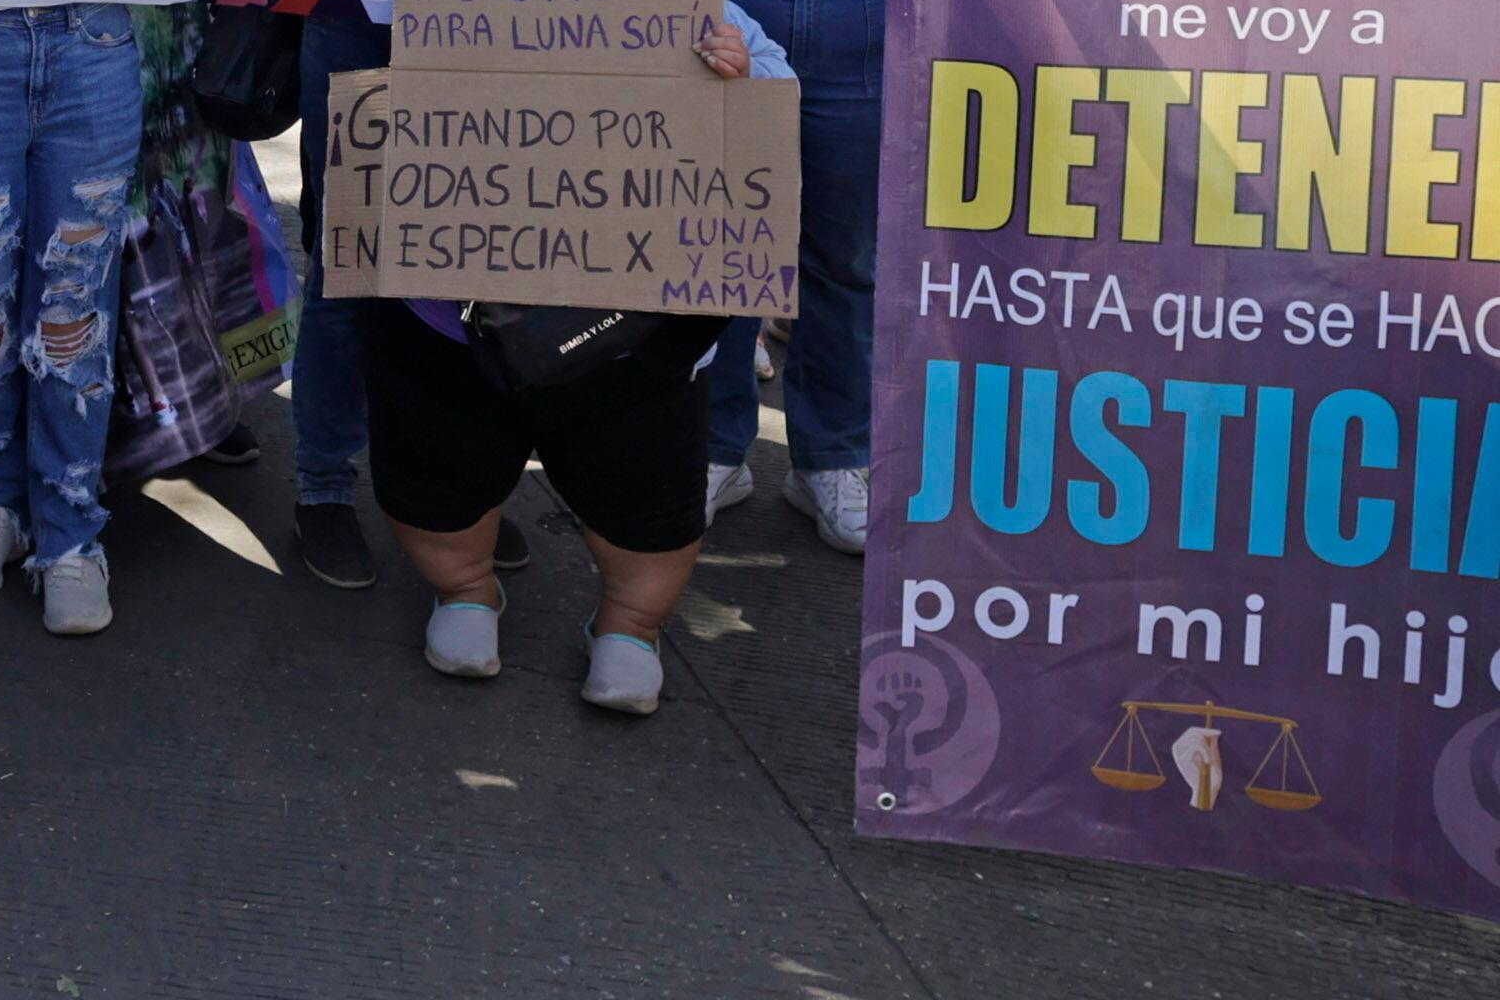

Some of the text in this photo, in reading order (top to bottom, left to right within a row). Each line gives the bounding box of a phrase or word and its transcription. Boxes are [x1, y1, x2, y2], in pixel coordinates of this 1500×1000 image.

[399, 13, 493, 49] PARA
[512, 14, 606, 51] LUNA
[1120, 1, 1384, 55] me voy a
[330, 84, 672, 166] ¡GRITANDO POR
[354, 159, 772, 210] TODAS LAS NIÑAS
[333, 217, 774, 273] EN ESPECIAL X LUNA
[688, 254, 700, 276] Y
[559, 331, 591, 354] BIMBA
[597, 311, 624, 331] LOLA
[920, 262, 1132, 333] HASTA
[1152, 292, 1263, 352] que
[1283, 301, 1355, 347] se
[901, 579, 1500, 708] por mi hij
